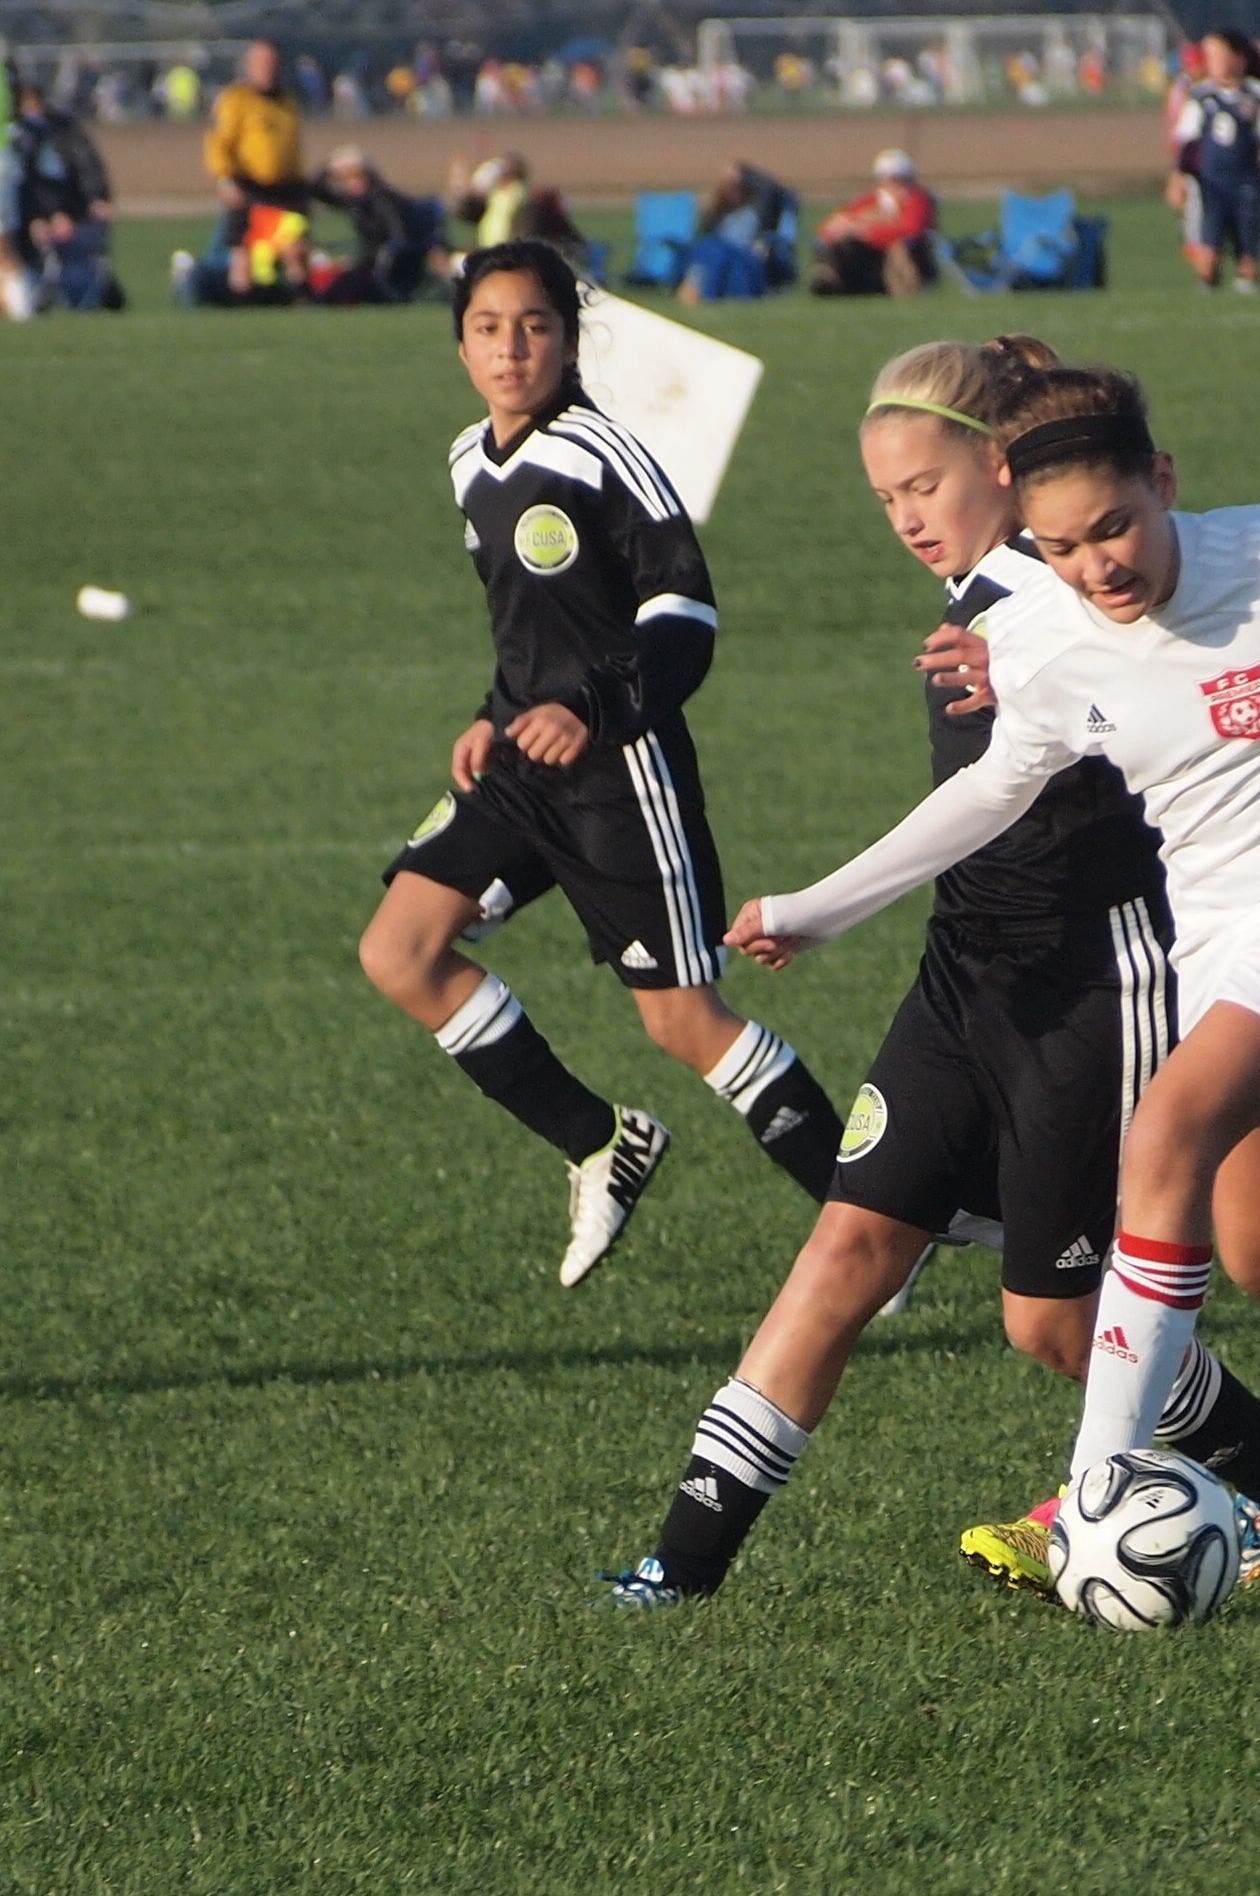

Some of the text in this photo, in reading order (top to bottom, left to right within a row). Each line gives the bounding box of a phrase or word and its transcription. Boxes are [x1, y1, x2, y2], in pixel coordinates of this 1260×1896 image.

[1216, 672, 1249, 691] FC
[607, 1114, 656, 1212] NIKE
[1055, 1253, 1100, 1269] adidas
[679, 1481, 723, 1512] adidas
